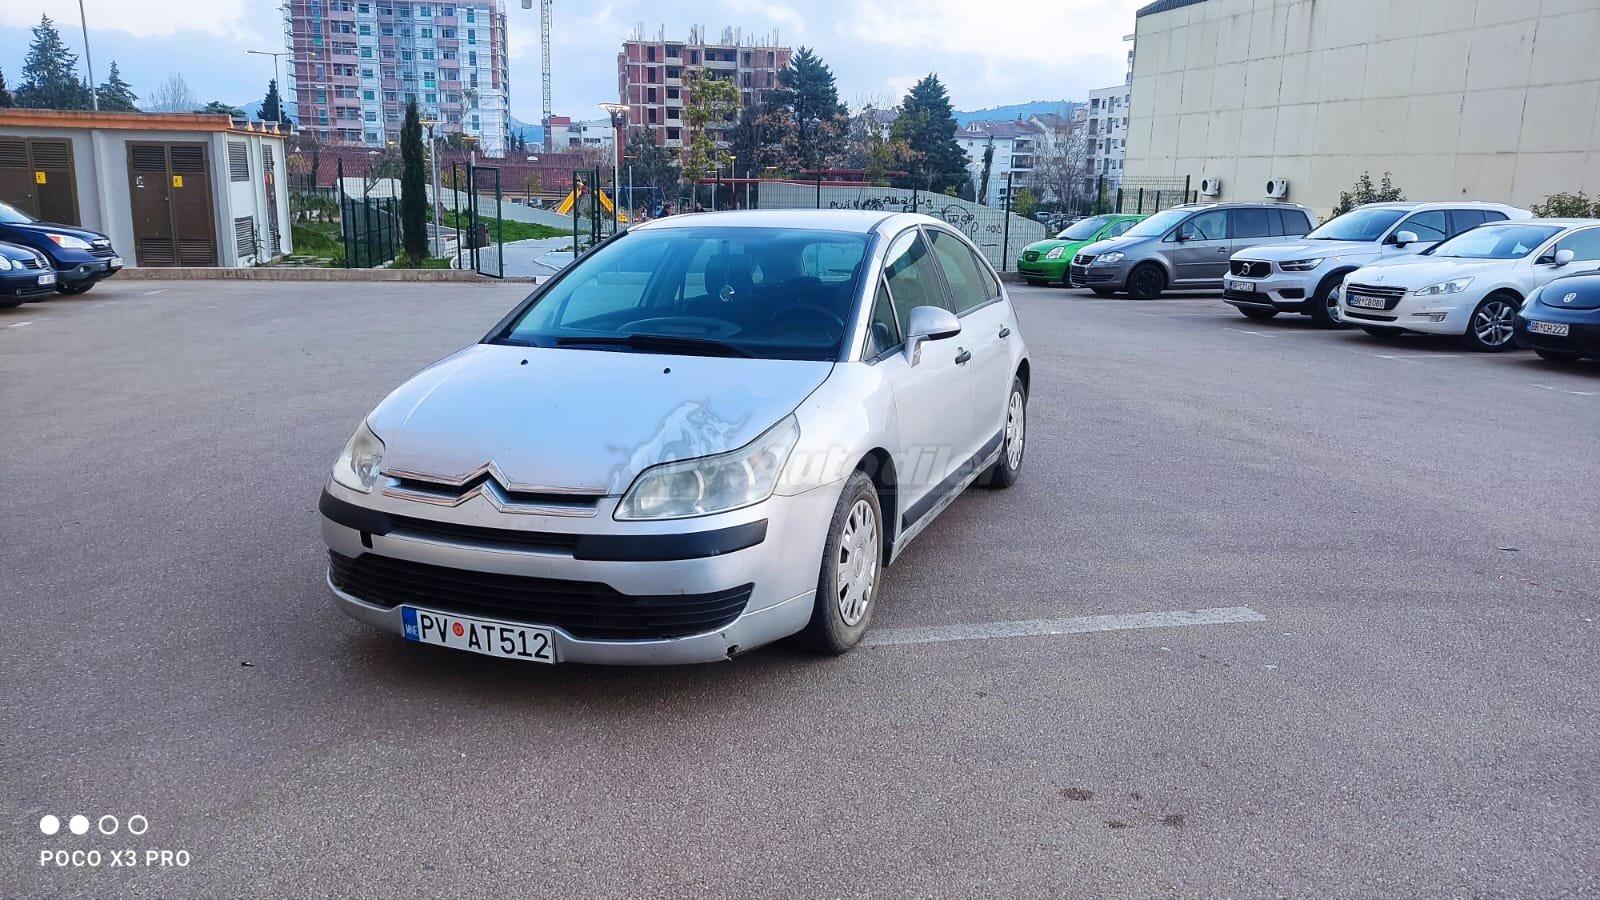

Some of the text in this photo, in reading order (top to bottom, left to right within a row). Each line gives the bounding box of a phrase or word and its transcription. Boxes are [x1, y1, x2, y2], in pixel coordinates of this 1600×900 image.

[1531, 321, 1568, 335] BR CH222
[405, 623, 419, 636] MNE
[420, 614, 550, 660] PV AT512
